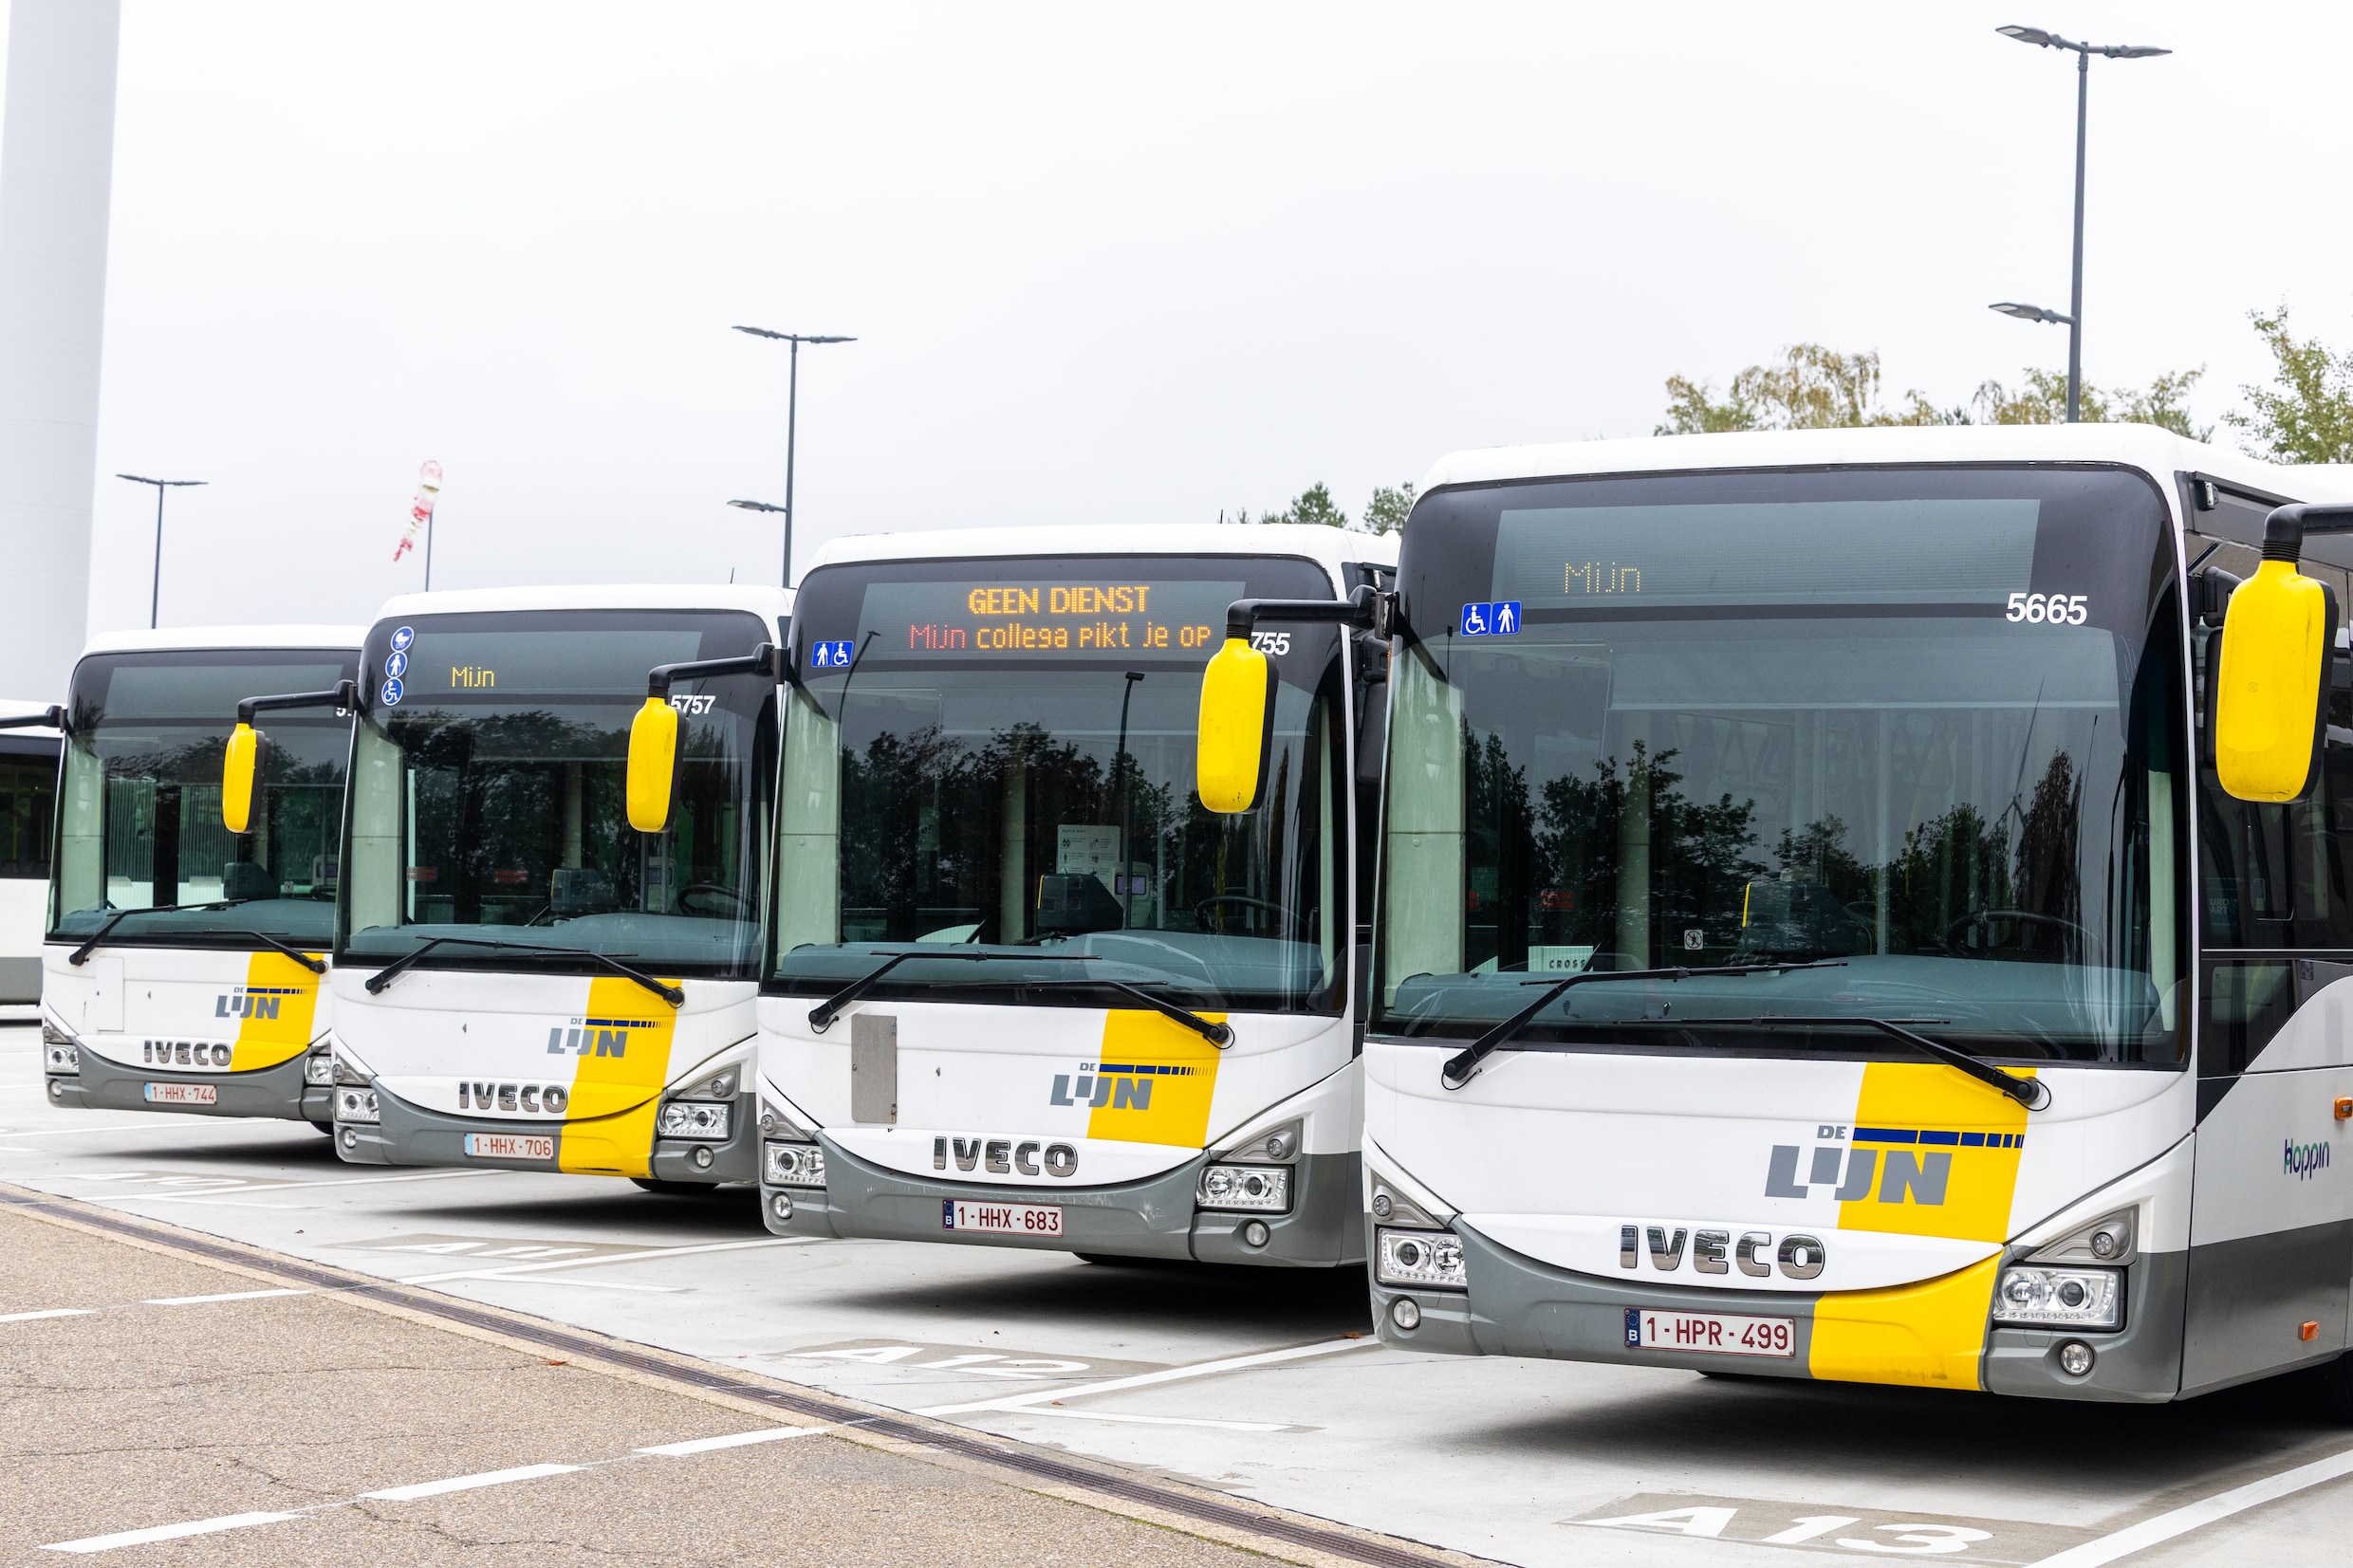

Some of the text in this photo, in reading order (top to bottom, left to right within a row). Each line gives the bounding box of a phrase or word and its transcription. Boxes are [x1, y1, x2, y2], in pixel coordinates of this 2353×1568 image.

[1565, 562, 1640, 593] Mijn
[969, 586, 1150, 614] GEEN DIENST
[2005, 592, 2088, 626] 5665
[910, 624, 966, 649] Mijn
[1079, 621, 1130, 648] pikt
[1142, 621, 1169, 648] je
[452, 666, 494, 688] Mijn
[670, 694, 716, 714] 5757
[214, 995, 281, 1020] LIJN
[569, 1017, 584, 1025] DE
[143, 1040, 232, 1067] IVECO
[547, 1027, 628, 1058] LIJN
[1079, 1062, 1096, 1072] DE
[458, 1081, 569, 1114] IVECO
[1049, 1074, 1154, 1111] LIJN
[1816, 1124, 1847, 1140] DE
[933, 1135, 1079, 1178] IVECO
[2283, 1138, 2330, 1182] Hoppin
[1764, 1144, 1953, 1207] LIJN
[945, 1215, 953, 1225] B
[1620, 1225, 1825, 1281] IVECO
[1628, 1329, 1638, 1341] B
